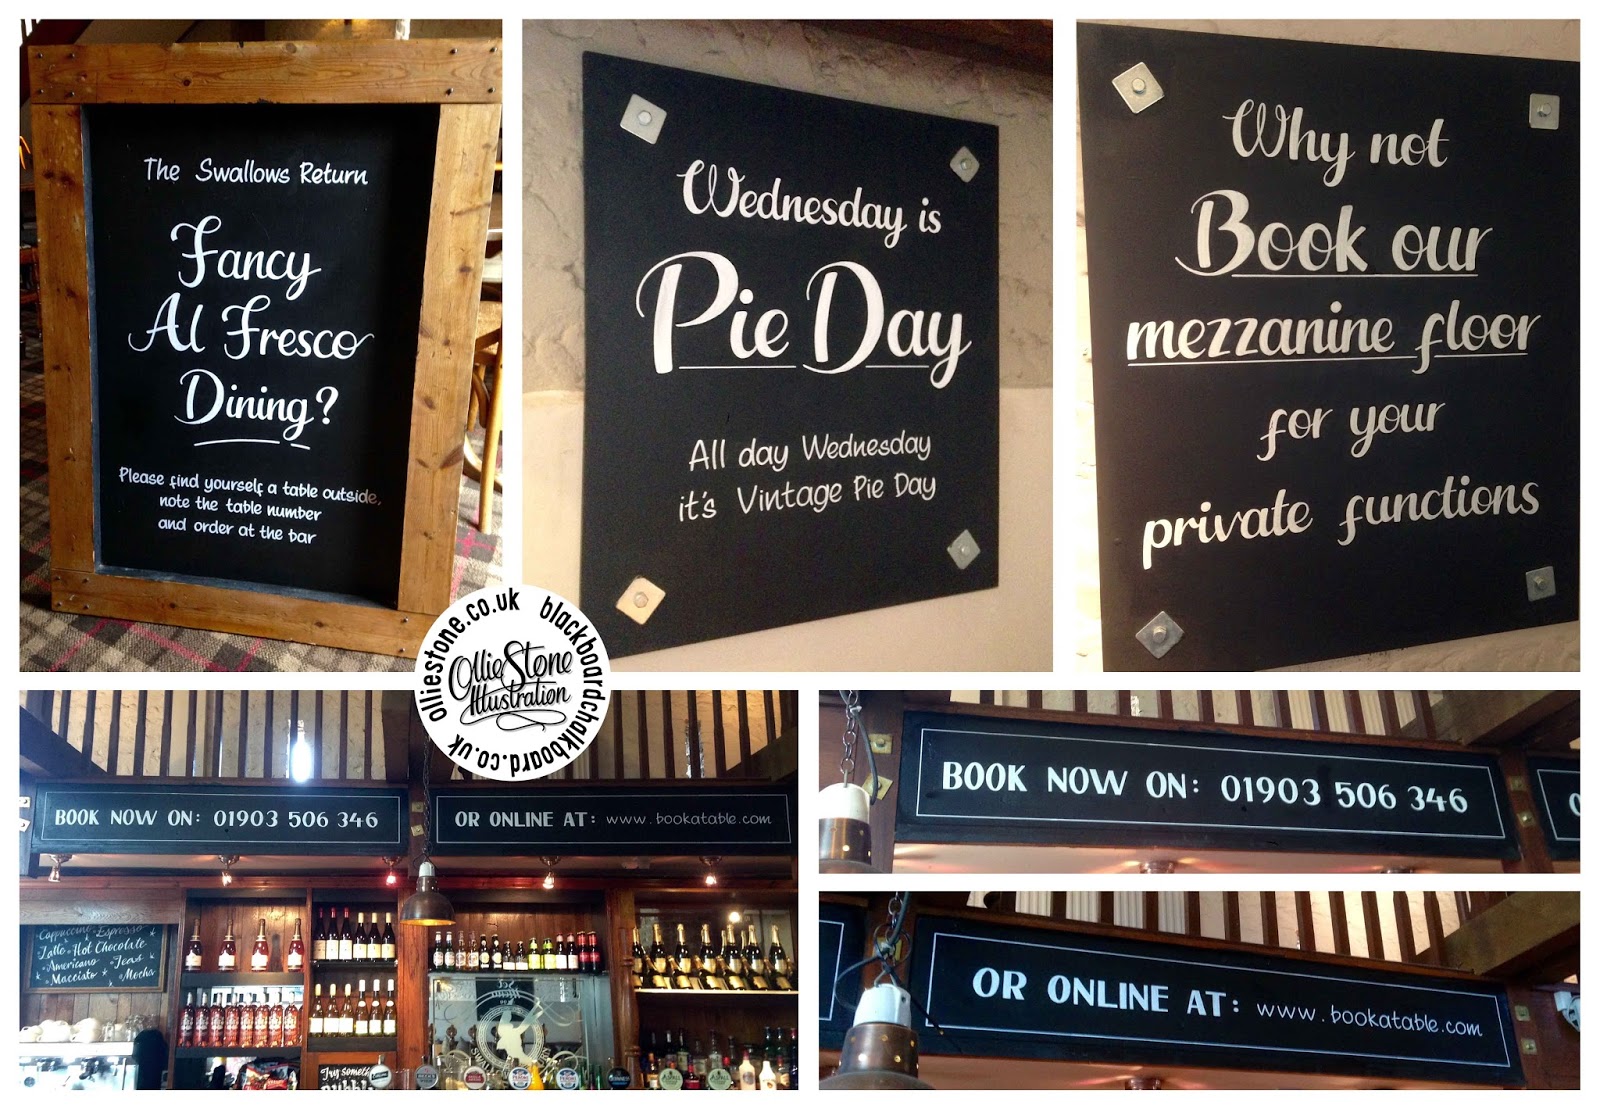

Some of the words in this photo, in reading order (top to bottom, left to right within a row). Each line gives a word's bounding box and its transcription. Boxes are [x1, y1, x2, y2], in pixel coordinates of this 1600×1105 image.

[1223, 99, 1355, 187] Why
[1370, 119, 1448, 167] not
[144, 158, 180, 181] The
[195, 158, 290, 183] Swallows
[300, 162, 368, 185] Return
[677, 160, 907, 248] Wednesday
[919, 198, 941, 233] is
[1175, 190, 1367, 276] Book
[1392, 225, 1492, 271] our
[171, 216, 321, 300] Fancy
[128, 293, 205, 352] Al
[222, 295, 374, 359] Fresco
[636, 251, 789, 374] Pie
[803, 261, 972, 389] Day
[1126, 301, 1395, 360] mezzanine
[1412, 300, 1541, 374] floor
[174, 369, 338, 441] Dining?
[689, 439, 725, 471] All
[739, 438, 788, 472] day
[802, 430, 930, 460] Wednesday
[1257, 409, 1333, 461] for
[1350, 403, 1445, 457] your
[119, 467, 164, 485] Please
[170, 474, 199, 489] find
[204, 478, 263, 497] yourself
[268, 484, 277, 494] a
[282, 481, 318, 498] table
[322, 486, 382, 506] outside,
[160, 494, 190, 508] note
[195, 496, 218, 511] the
[226, 498, 262, 514] table
[267, 504, 322, 522] number
[679, 491, 716, 522] it's
[737, 481, 842, 514] Vintage
[854, 475, 883, 500] Pie
[894, 473, 936, 500] Day
[158, 518, 186, 530] and
[194, 520, 234, 534] order
[239, 523, 255, 537] at
[259, 525, 283, 540] the
[288, 528, 316, 545] bar
[1143, 489, 1313, 570] private
[1338, 476, 1539, 545] functions
[943, 762, 1027, 791] BOOK
[1048, 767, 1128, 795] NOW
[1146, 771, 1198, 798] ON:
[1221, 775, 1320, 805] 01903
[1335, 782, 1396, 809] 506
[1408, 786, 1467, 812] 346
[55, 809, 99, 826] BOOK
[111, 809, 157, 825] NOW
[168, 810, 199, 826] ON:
[214, 810, 277, 827] 01903
[289, 811, 328, 827] 506
[338, 812, 378, 827] 346
[455, 811, 479, 827] OR
[490, 812, 553, 827] ONLINE
[564, 812, 595, 826] AT:
[38, 943, 67, 960] Latte
[71, 941, 93, 957] Hot
[95, 938, 147, 953] Chocolate
[96, 925, 146, 939] Espresso
[46, 958, 99, 972] Americano
[121, 967, 155, 982] Mocha
[973, 968, 1026, 1000] OR
[1048, 975, 1168, 1012] ONLINE
[1187, 990, 1238, 1016] AT:
